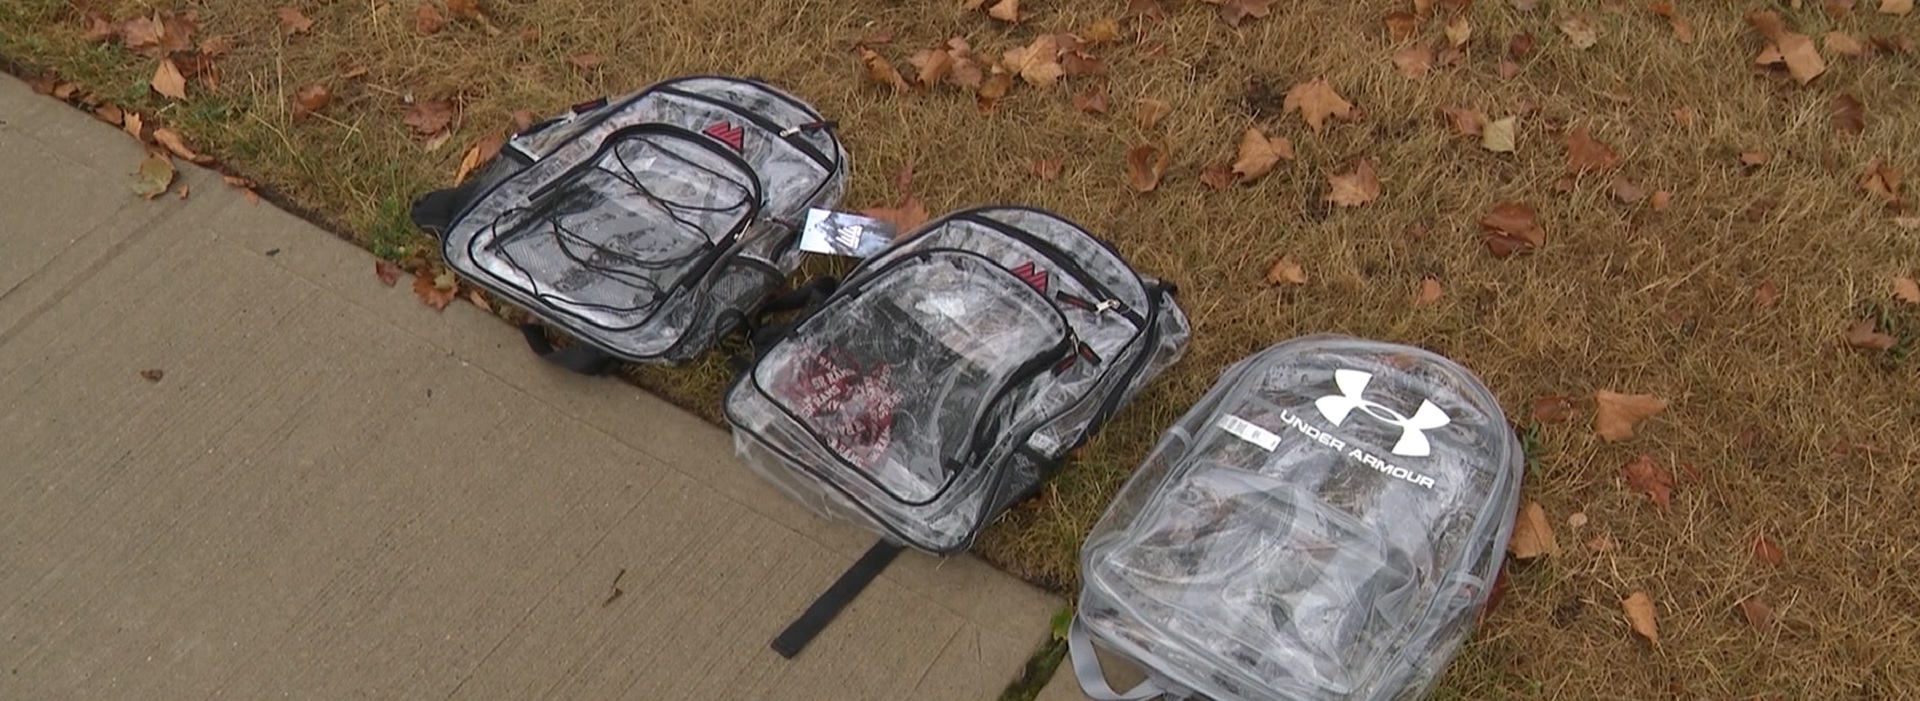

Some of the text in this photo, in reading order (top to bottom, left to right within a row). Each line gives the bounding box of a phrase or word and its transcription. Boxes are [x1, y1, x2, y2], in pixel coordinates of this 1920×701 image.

[813, 384, 841, 408] RAMS
[1280, 409, 1346, 452] UNDER
[1348, 446, 1436, 490] ARMOUR
